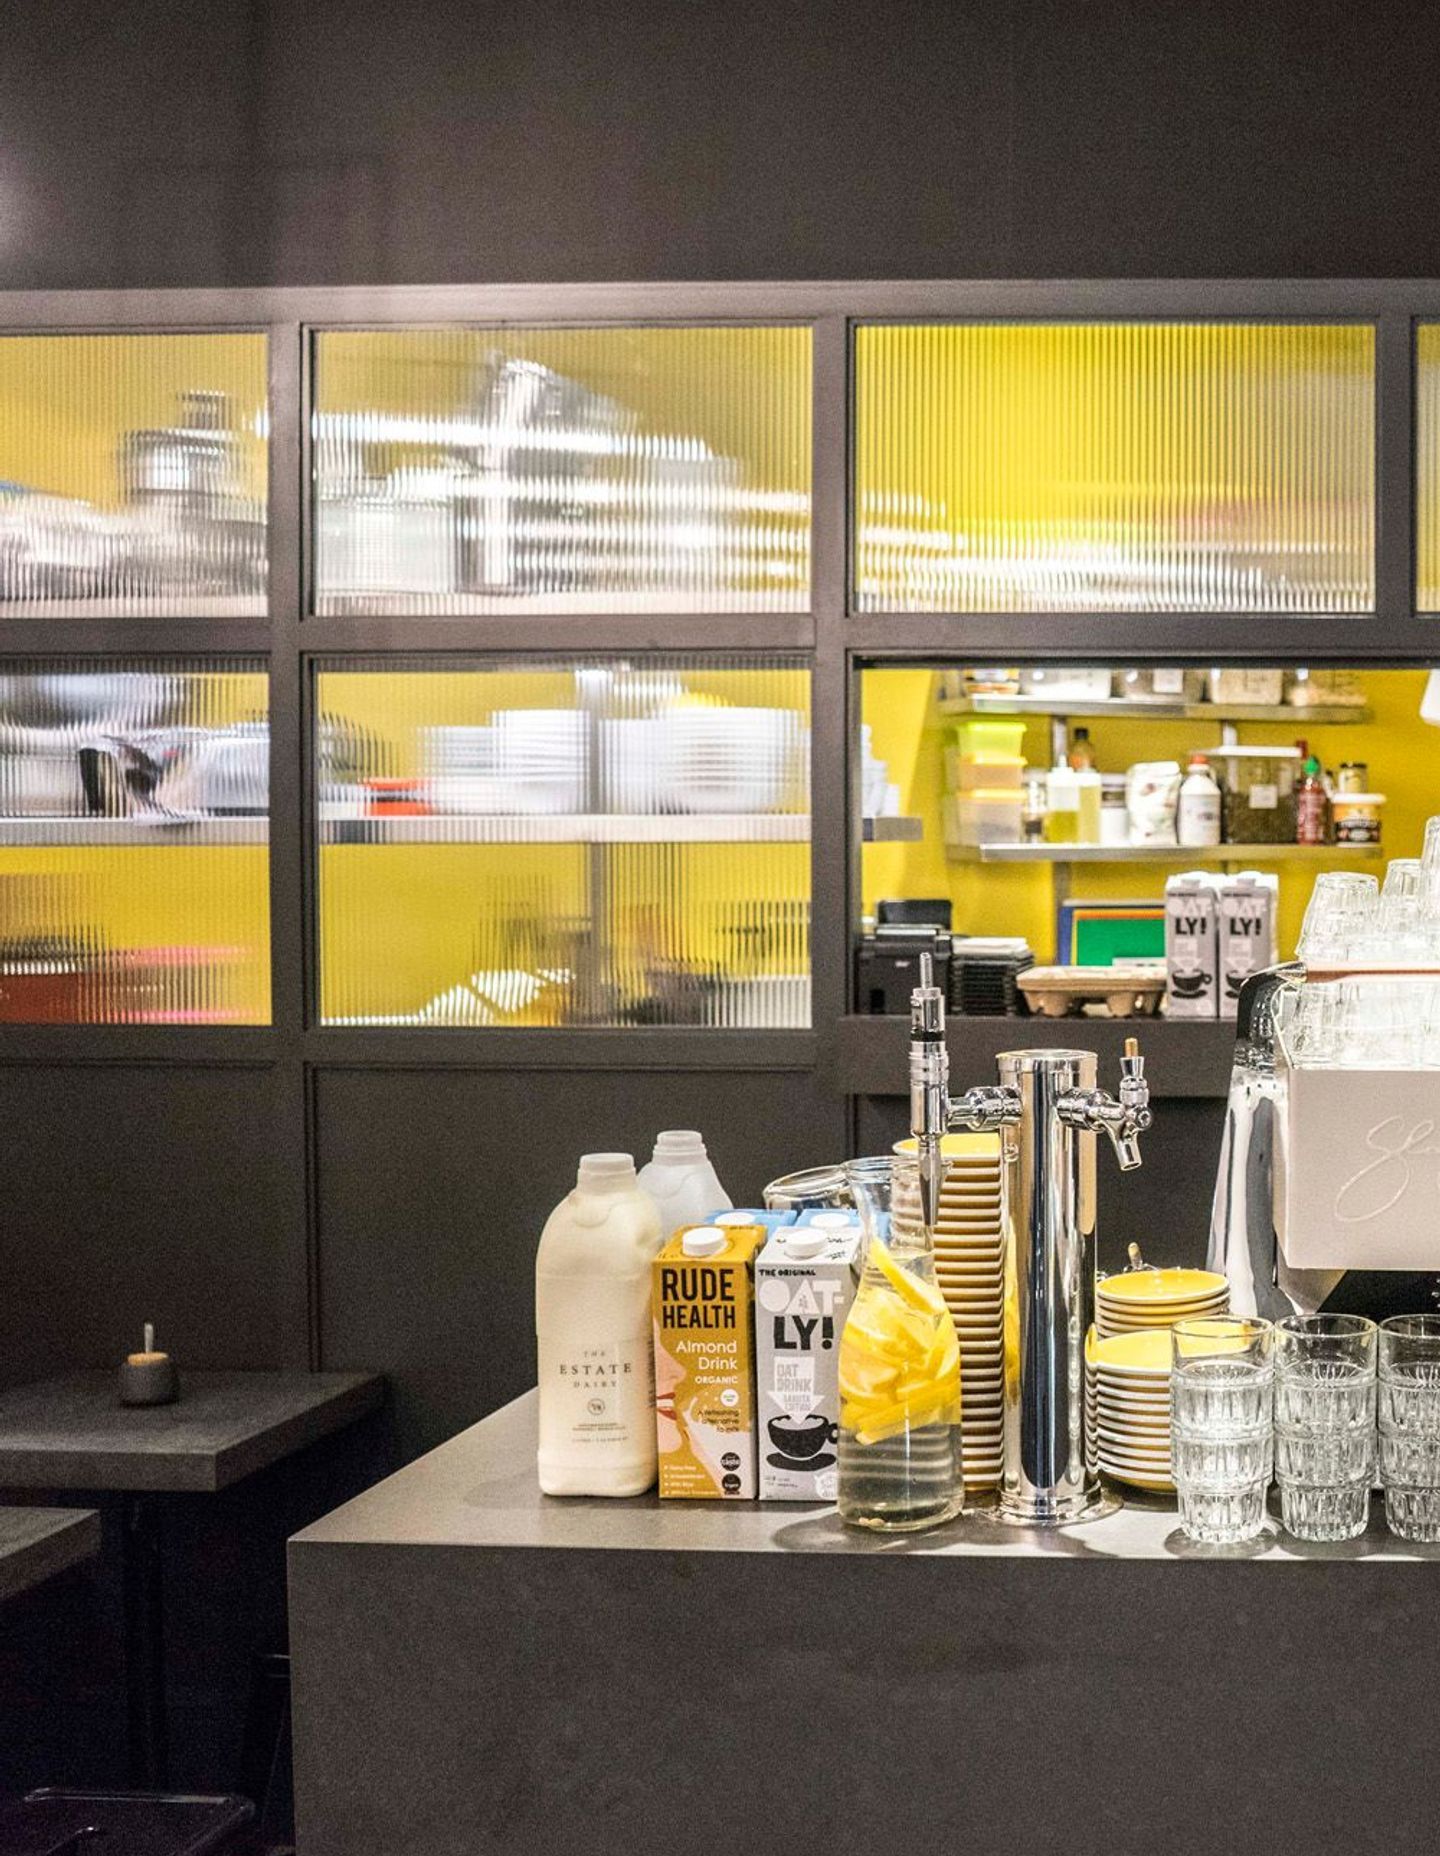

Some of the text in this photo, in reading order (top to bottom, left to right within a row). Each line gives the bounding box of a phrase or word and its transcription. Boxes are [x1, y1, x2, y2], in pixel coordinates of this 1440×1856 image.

[1175, 917, 1207, 936] LY!
[1229, 917, 1262, 936] LY!
[758, 1269, 816, 1277] THE ORIGINAL
[661, 1268, 735, 1301] RUDE
[662, 1305, 736, 1329] HEALTH
[773, 1315, 834, 1351] LY!
[676, 1340, 737, 1354] Almond
[560, 1363, 632, 1376] ESTATE
[698, 1357, 738, 1370] Drink
[776, 1363, 799, 1378] OAT
[695, 1375, 738, 1385] ORGANIC
[776, 1377, 812, 1393] DRINK
